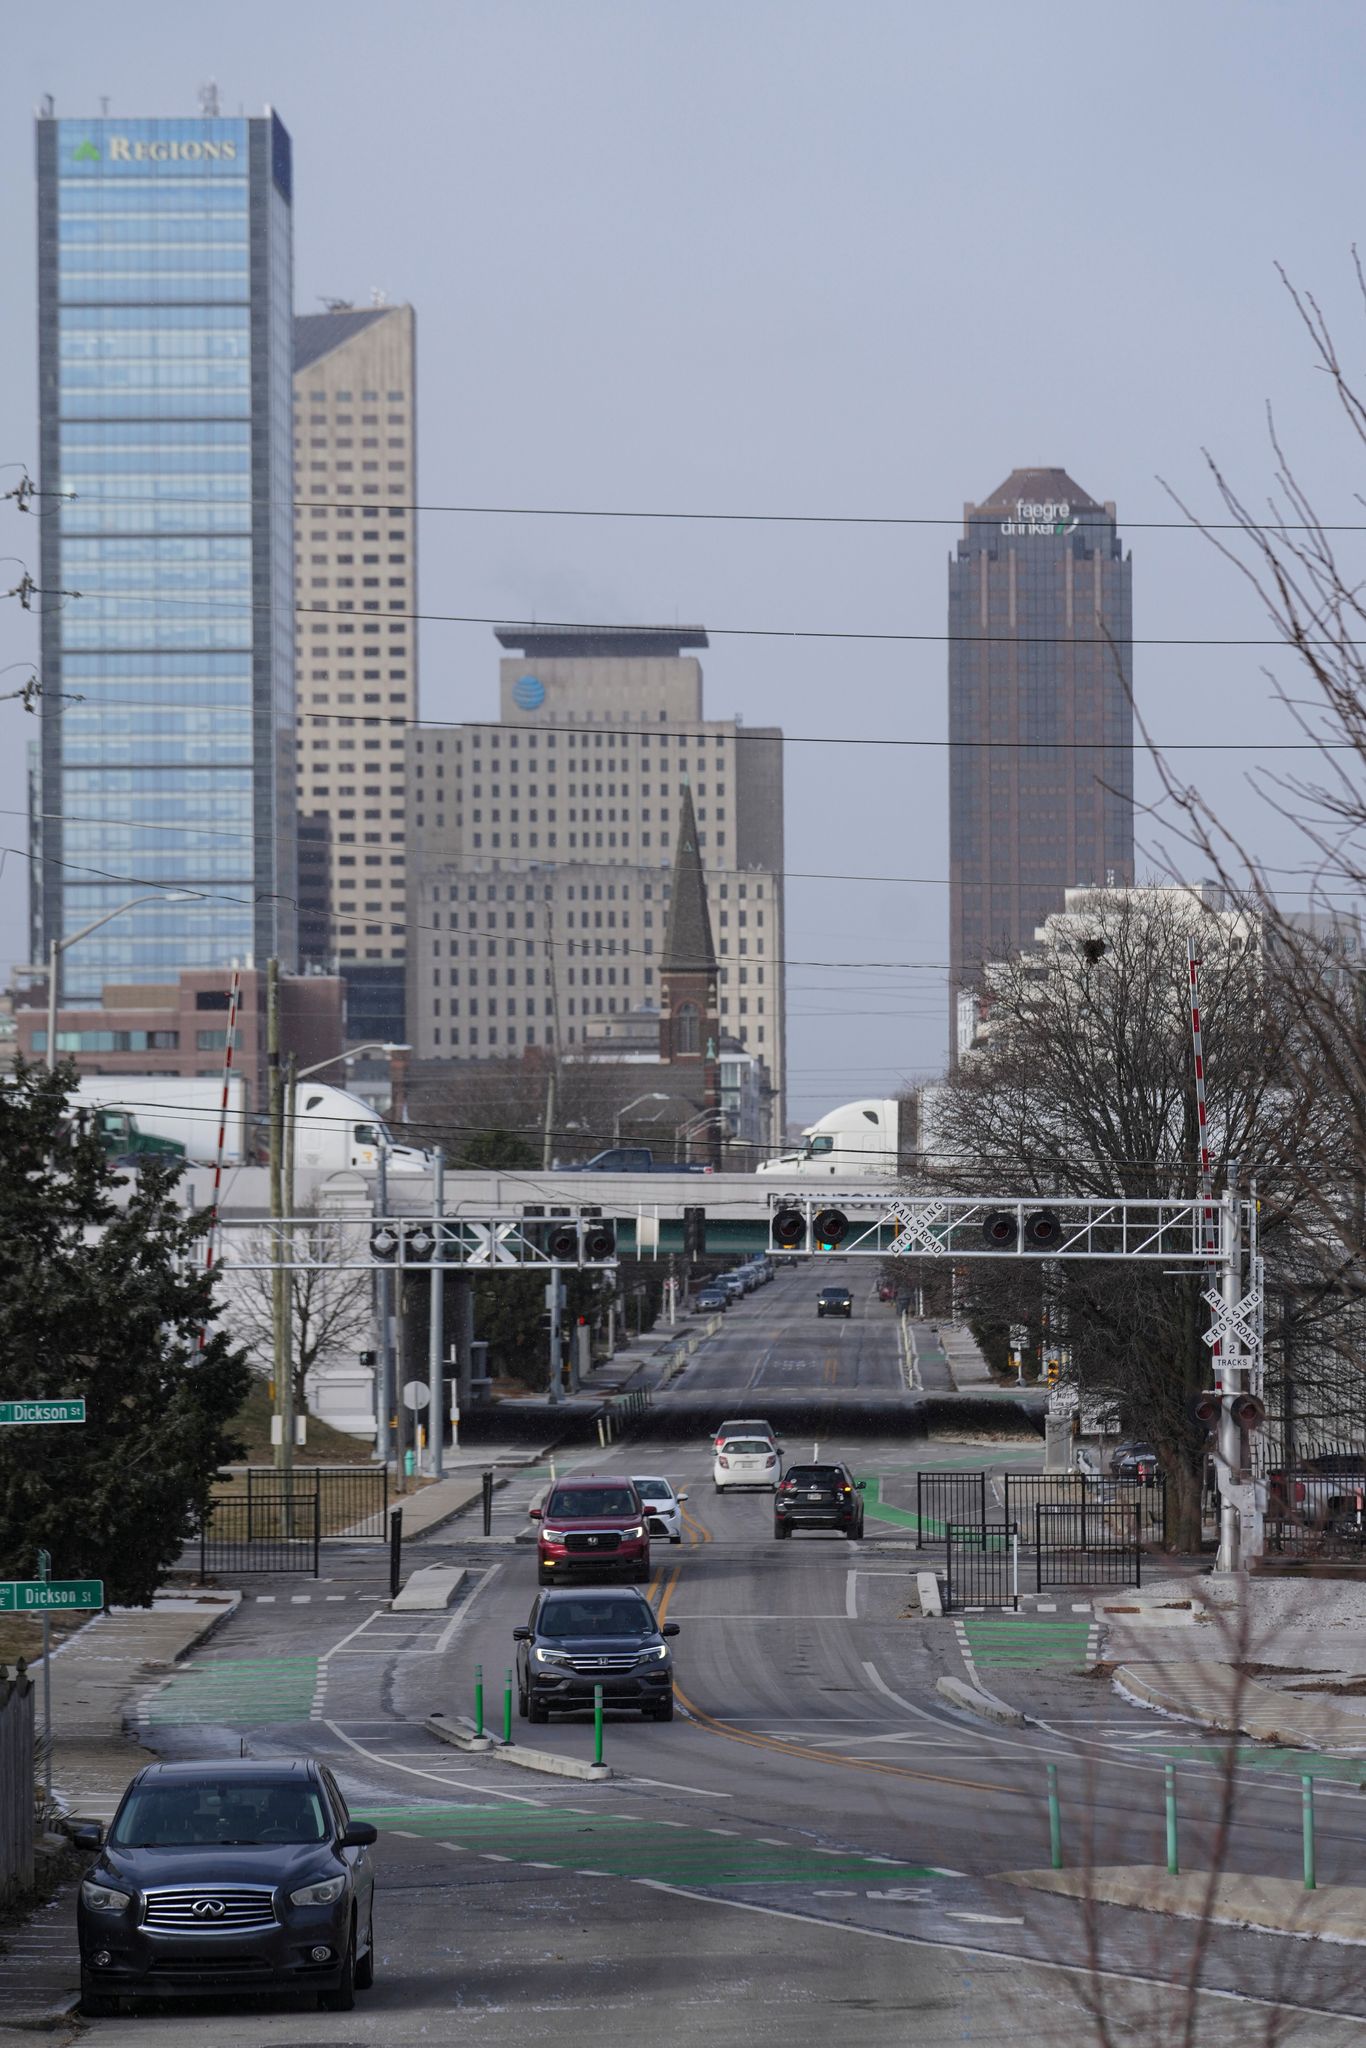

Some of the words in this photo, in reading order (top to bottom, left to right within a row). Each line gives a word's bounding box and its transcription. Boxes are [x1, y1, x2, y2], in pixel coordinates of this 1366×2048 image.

[109, 135, 237, 161] REGIONS
[1017, 499, 1070, 522] faegre
[1001, 516, 1056, 536] drinker
[890, 1202, 942, 1254] CROSSING
[1205, 1293, 1260, 1344] CROSSING
[1229, 1345, 1235, 1354] 2
[14, 1405, 68, 1420] Dickson
[70, 1407, 81, 1416] St
[25, 1588, 76, 1604] Dickson
[82, 1591, 92, 1602] St
